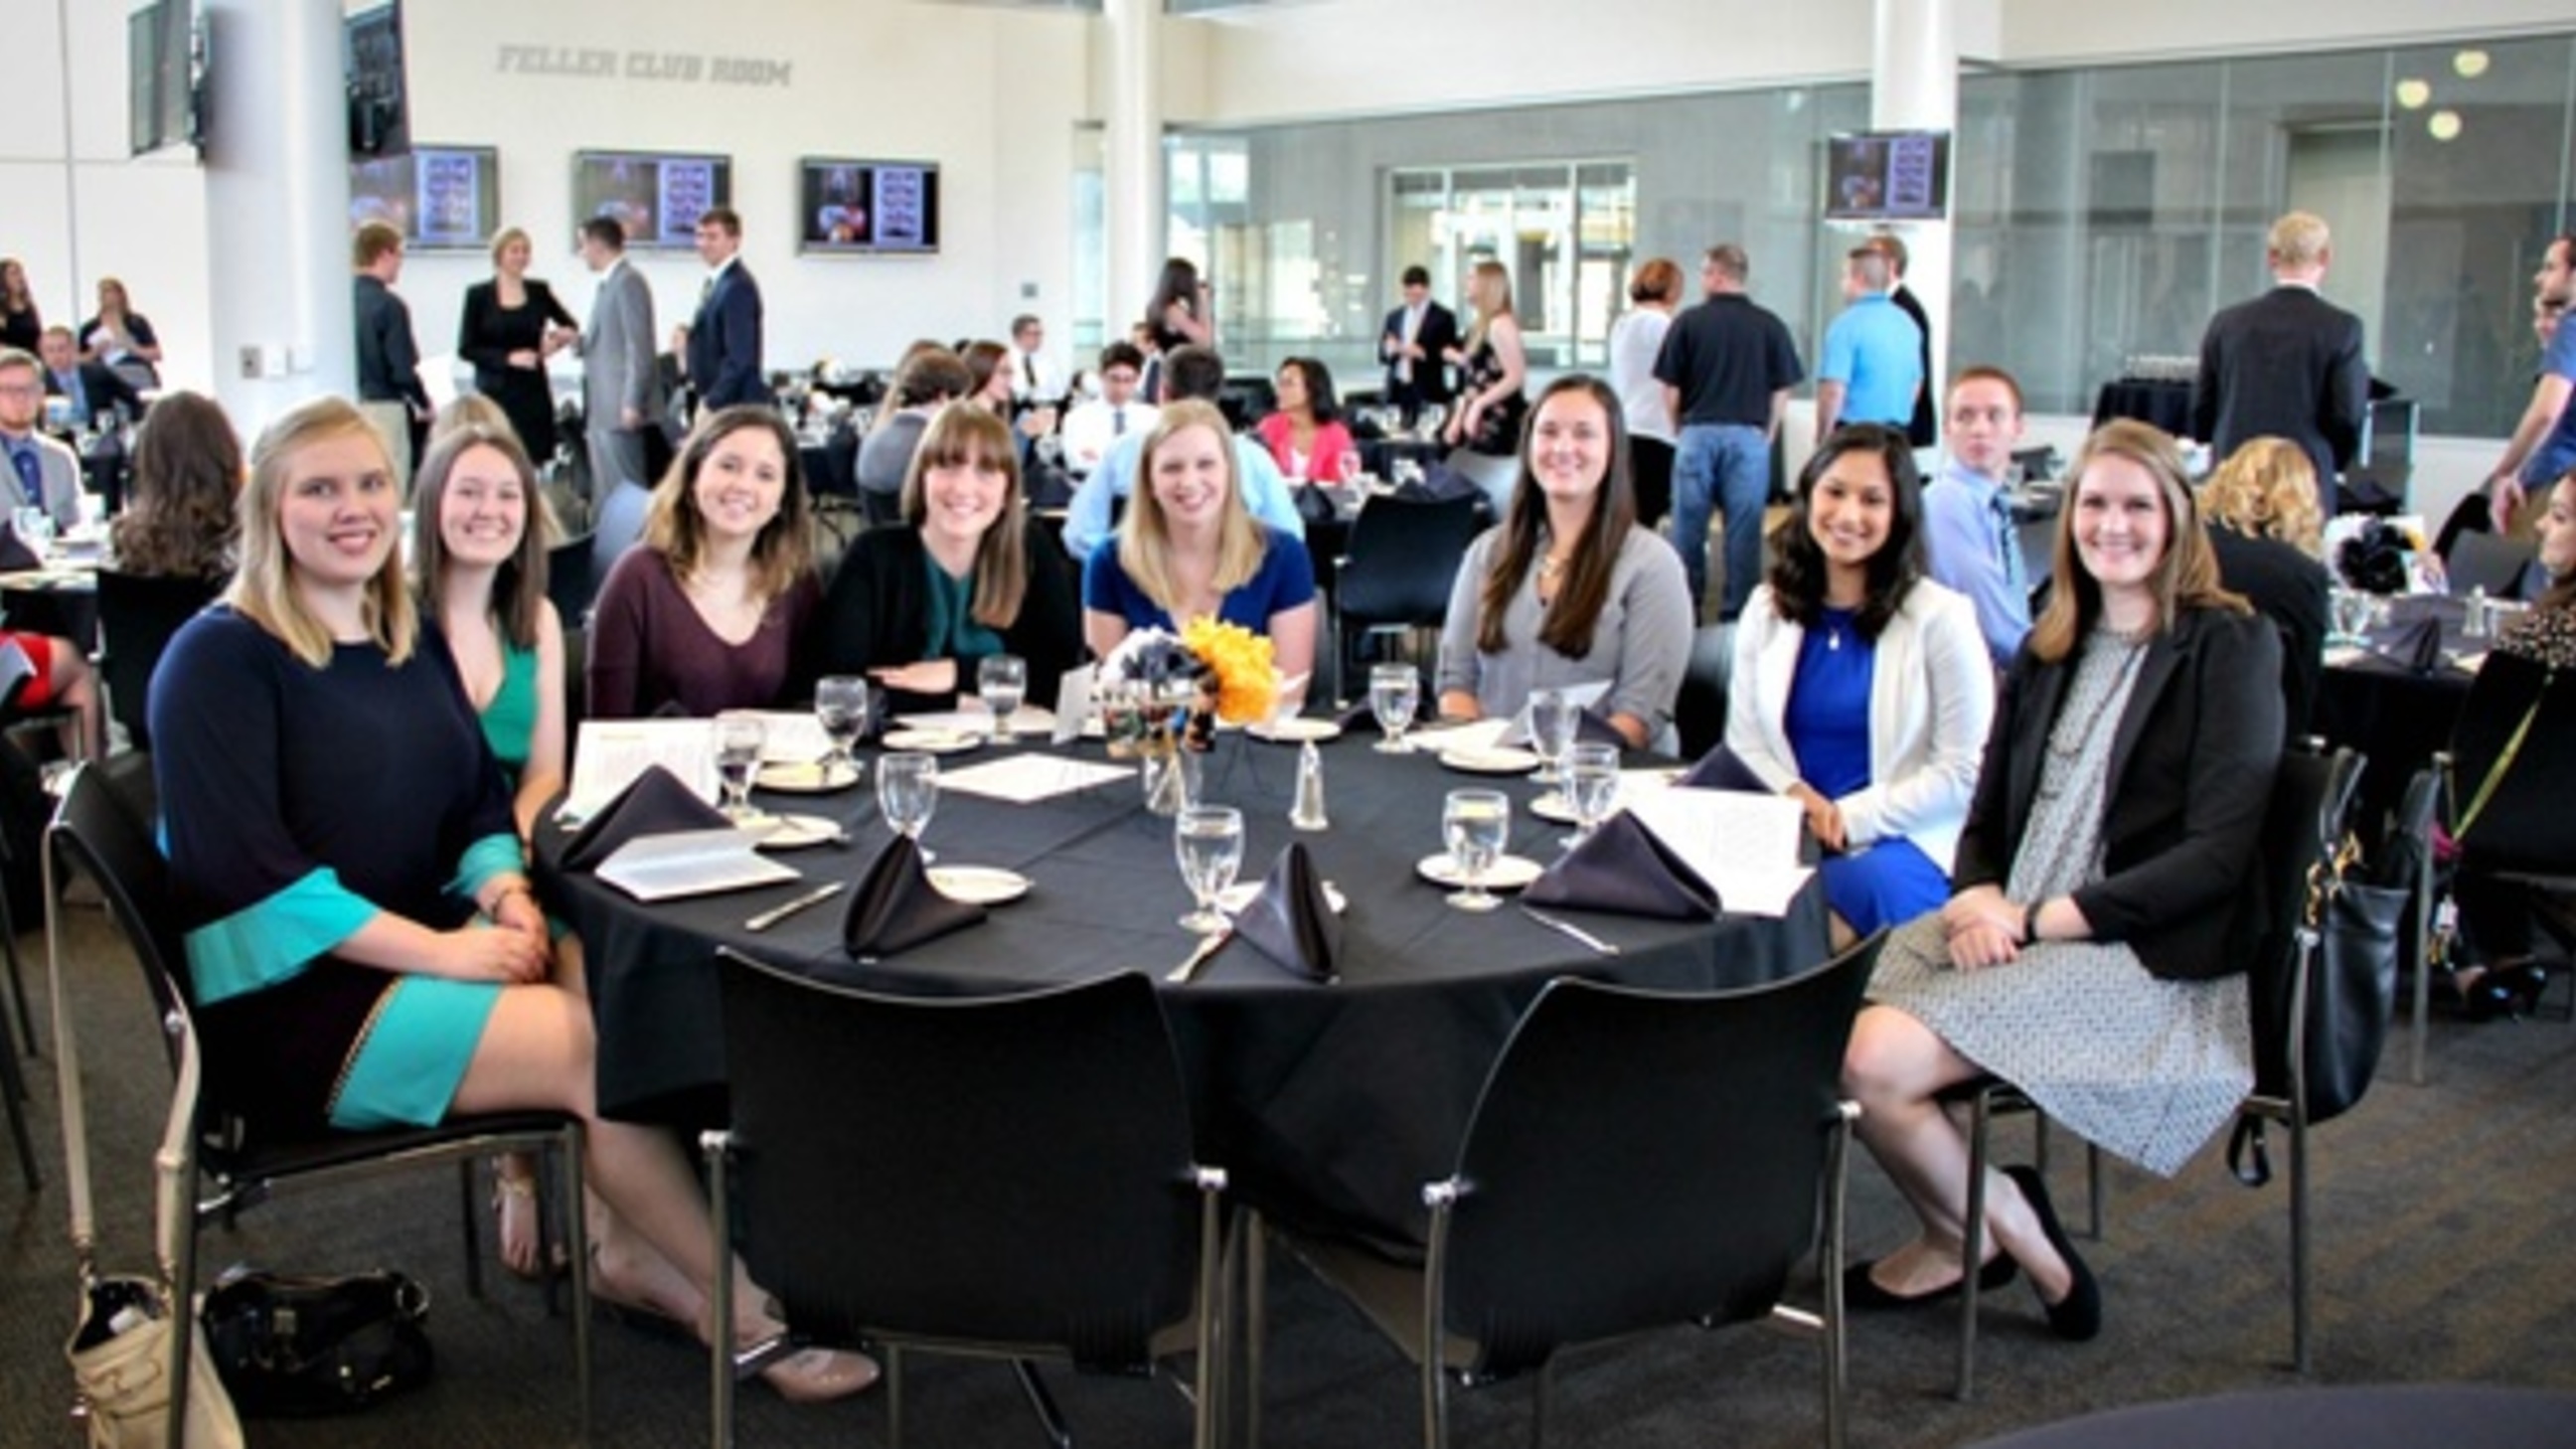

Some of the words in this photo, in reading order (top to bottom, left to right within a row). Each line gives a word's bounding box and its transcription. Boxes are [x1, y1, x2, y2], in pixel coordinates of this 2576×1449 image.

[496, 45, 617, 77] FELLER
[625, 51, 704, 82] CLUB
[711, 56, 793, 87] ROOM
